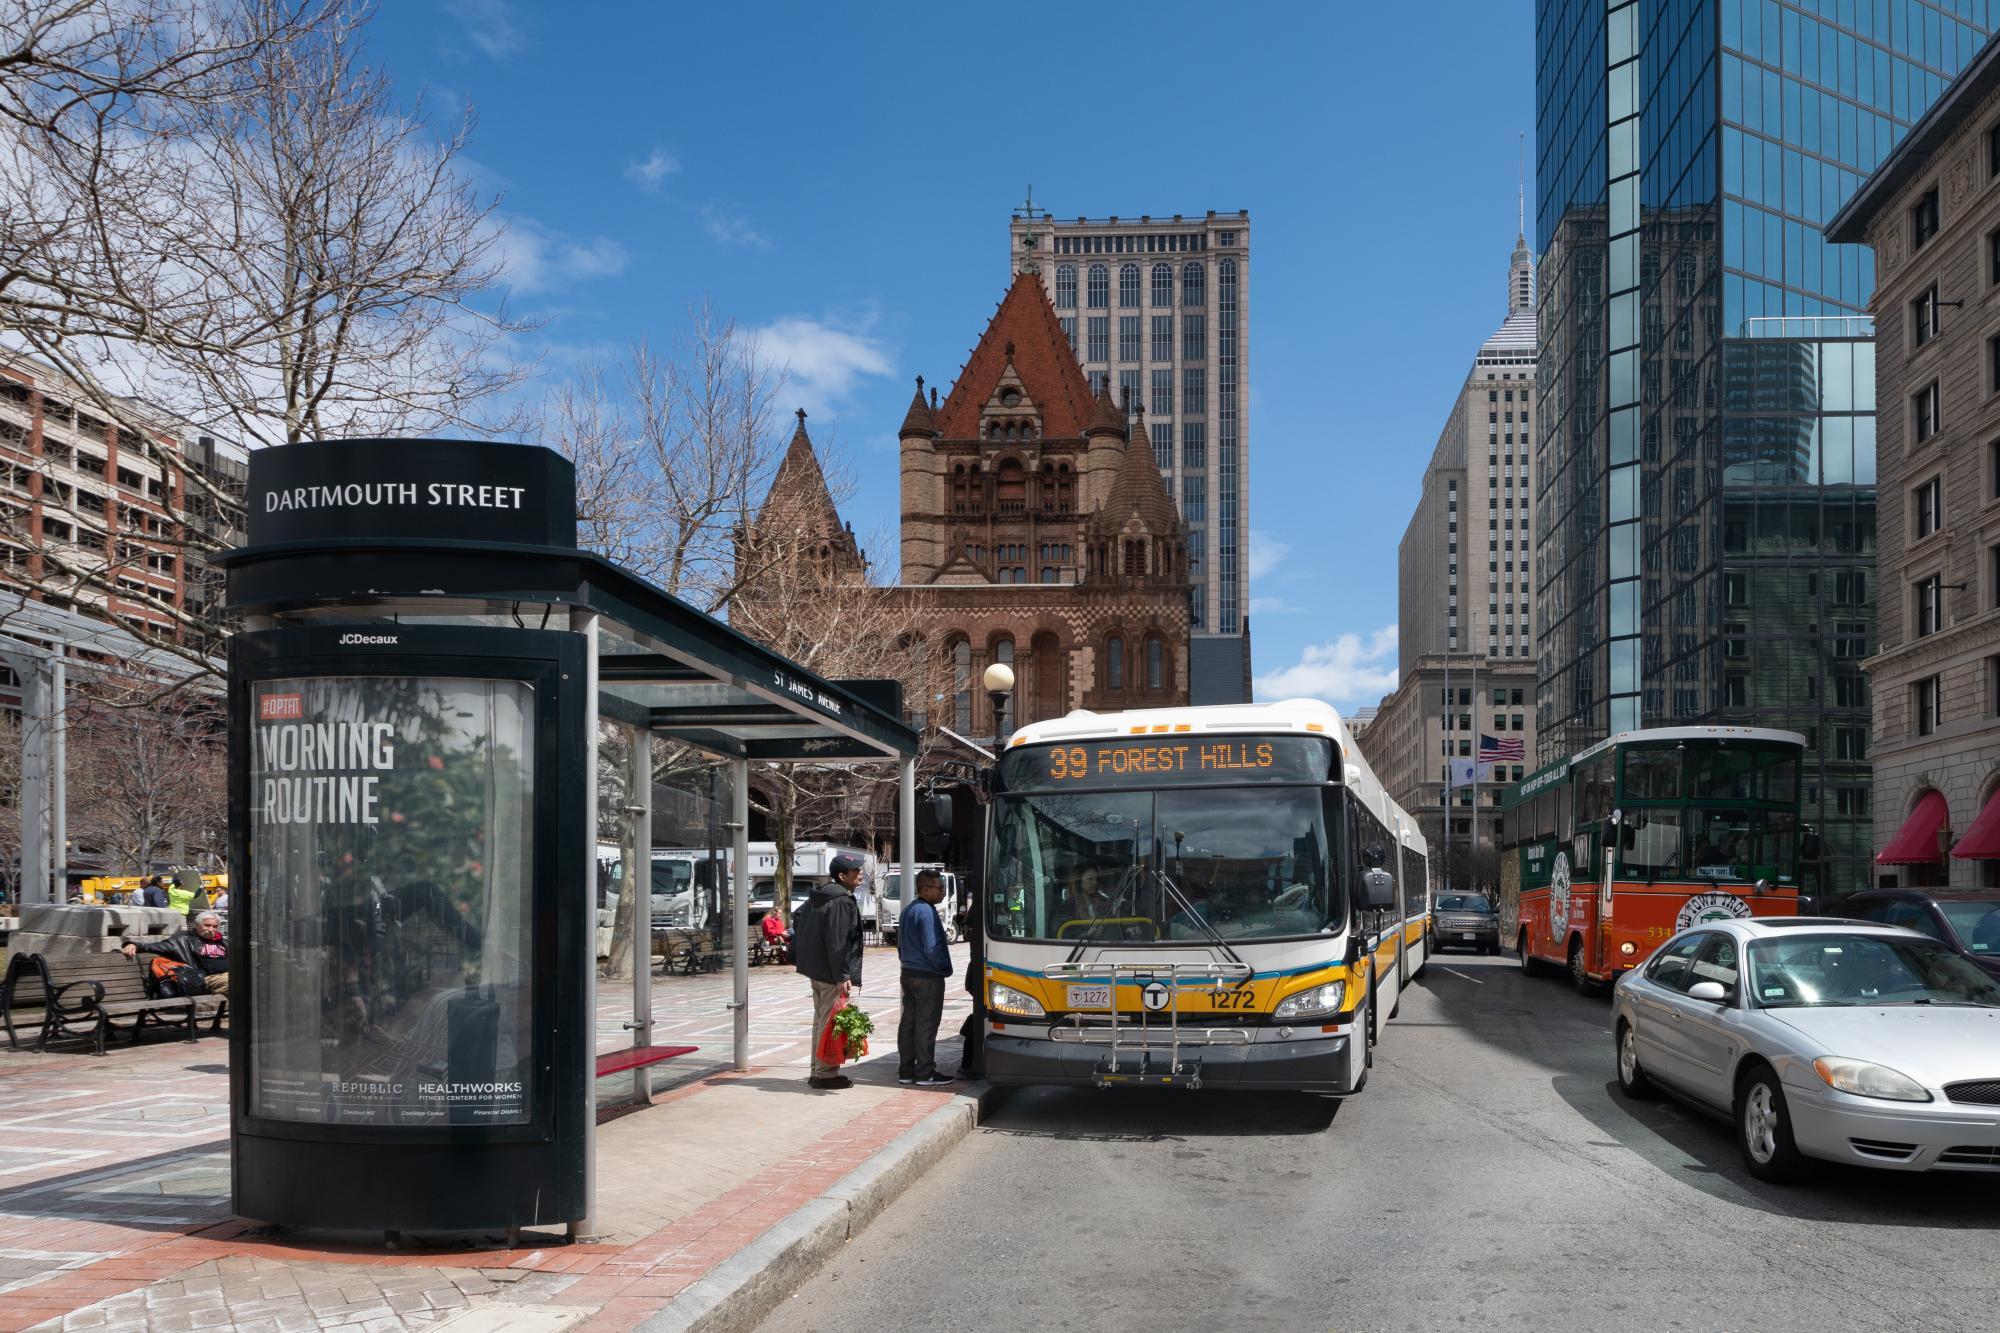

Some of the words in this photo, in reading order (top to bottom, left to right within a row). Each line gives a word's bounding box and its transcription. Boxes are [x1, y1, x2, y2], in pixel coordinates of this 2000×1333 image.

[266, 483, 416, 513] DARTMOUTH
[428, 483, 525, 509] STREET
[339, 634, 398, 645] JCDecaux
[774, 670, 784, 687] ST
[788, 677, 813, 701] JAMES
[818, 691, 841, 715] AVENUE
[261, 722, 394, 771] MORNING
[1049, 747, 1088, 779] 39
[1098, 746, 1189, 774] FOREST
[1201, 743, 1273, 769] HILLS
[264, 776, 379, 825] ROUTINE
[760, 856, 801, 867] PIK
[1687, 894, 1718, 914] TOWN
[1648, 927, 1673, 938] 534
[1084, 991, 1108, 1003] 1272
[1147, 990, 1165, 1006] T
[1207, 990, 1255, 1009] 1272
[332, 1082, 403, 1094] REPUBLIC
[418, 1082, 522, 1094] HEALTHWORKS
